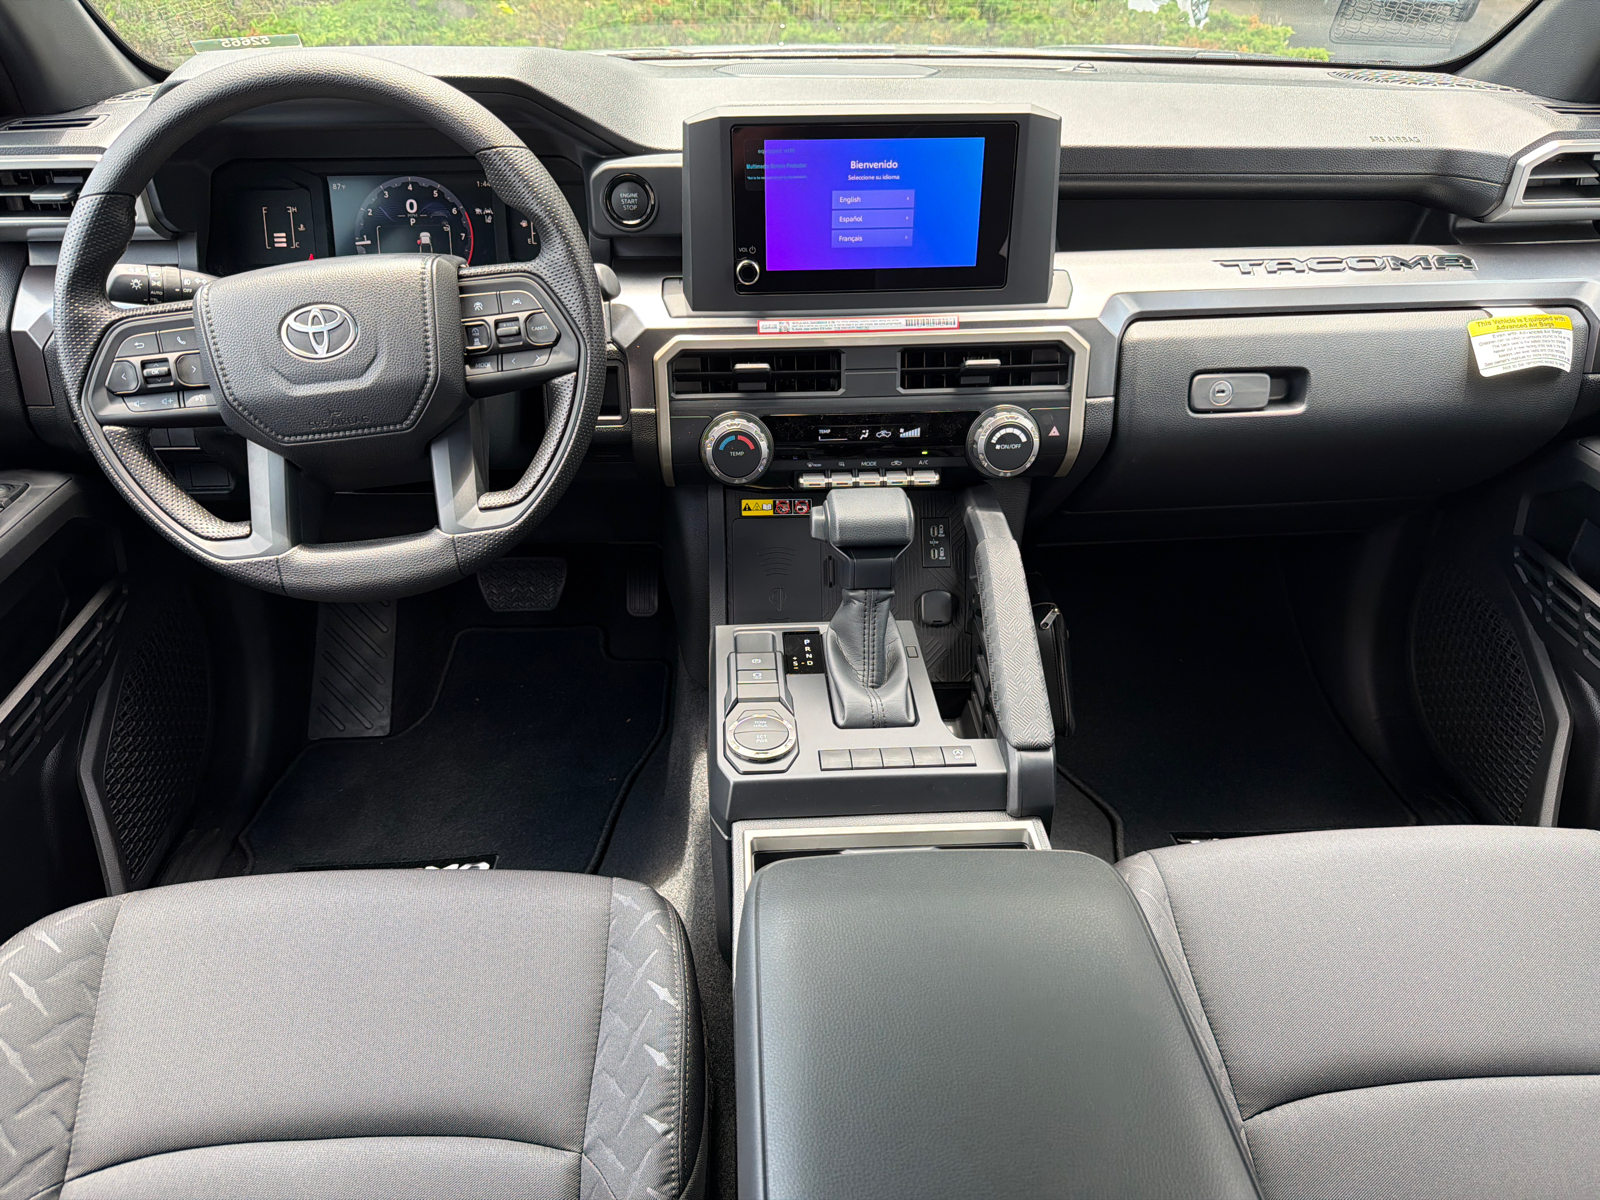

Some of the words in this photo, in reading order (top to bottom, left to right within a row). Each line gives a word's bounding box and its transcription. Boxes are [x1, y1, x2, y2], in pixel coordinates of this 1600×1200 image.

[1369, 135, 1386, 143] SRS
[1388, 135, 1421, 143] AIRBAG
[850, 159, 899, 170] Bienvenido
[407, 183, 413, 191] 4
[383, 190, 389, 199] 3
[432, 190, 439, 198] 5
[839, 196, 862, 205] English
[405, 198, 418, 214] 0
[367, 208, 373, 216] 2
[451, 207, 458, 215] 6
[410, 217, 416, 227] P
[838, 215, 863, 224] Español
[460, 232, 466, 241] 7
[838, 234, 863, 243] Français
[1211, 254, 1478, 276] TACOMA
[1476, 320, 1492, 328] This
[1496, 323, 1528, 331] Advanced
[1539, 321, 1555, 329] Bags
